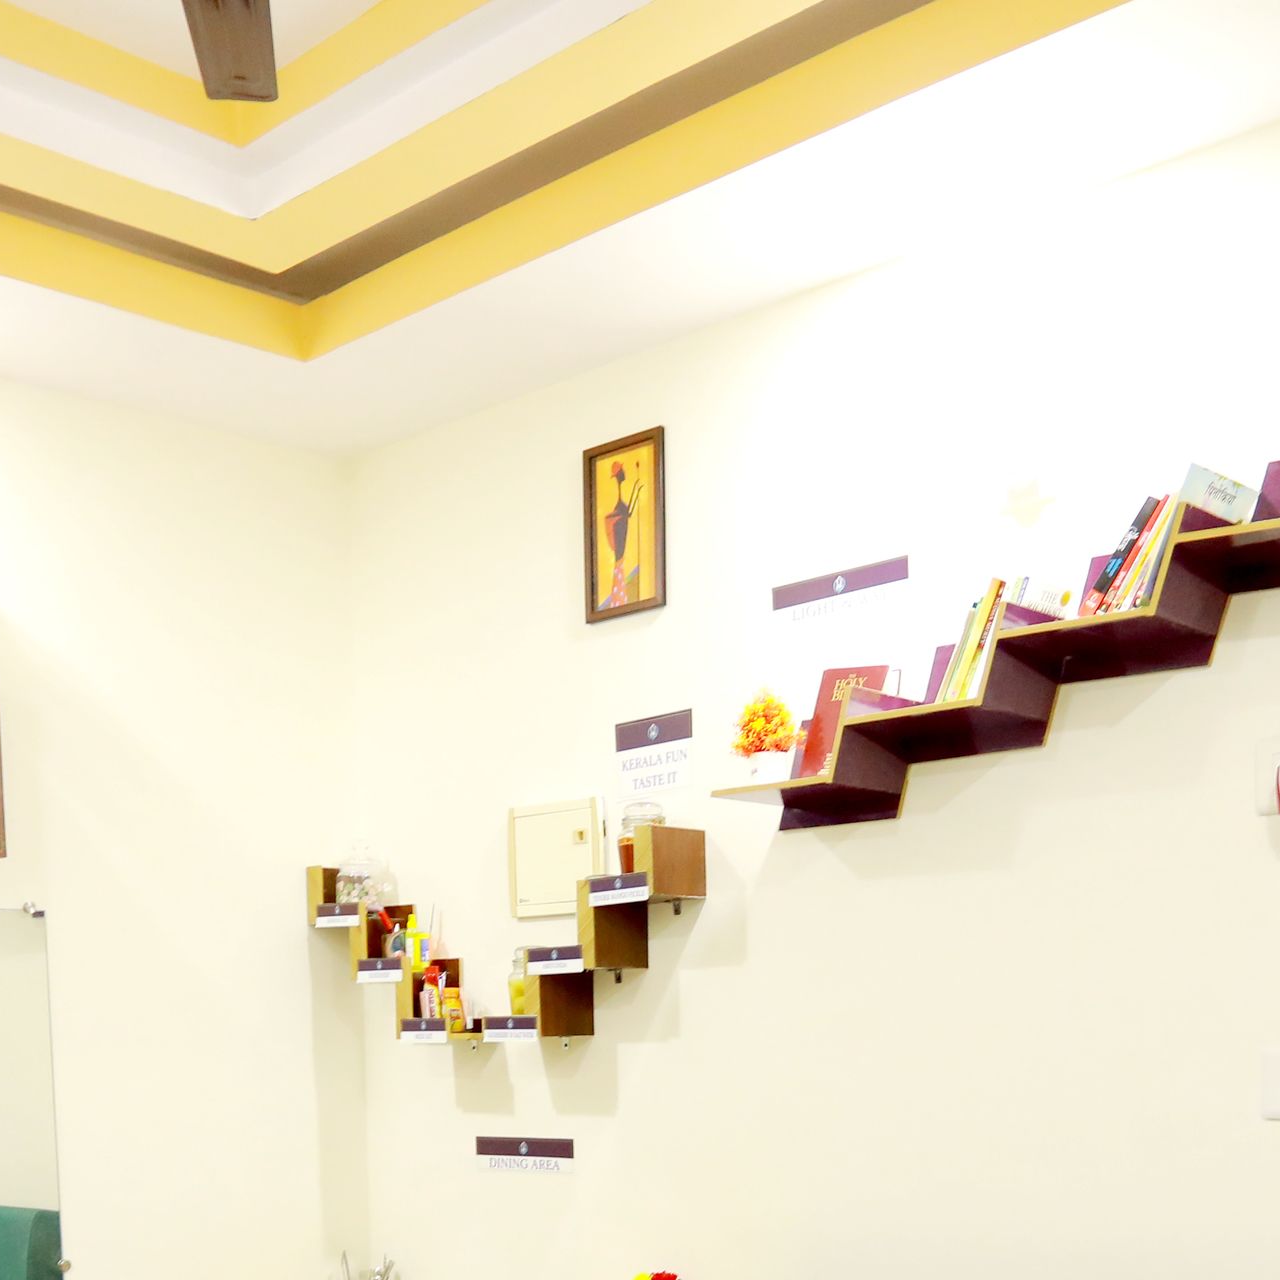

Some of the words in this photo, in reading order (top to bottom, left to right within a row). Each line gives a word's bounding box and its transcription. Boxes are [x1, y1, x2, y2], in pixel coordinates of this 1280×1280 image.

[834, 676, 868, 690] HOLY
[621, 754, 663, 772] KERALA
[665, 748, 688, 764] FUN
[632, 773, 665, 790] TASTE
[667, 771, 678, 784] IT
[489, 1157, 528, 1169] DINING
[532, 1159, 560, 1171] AREA
